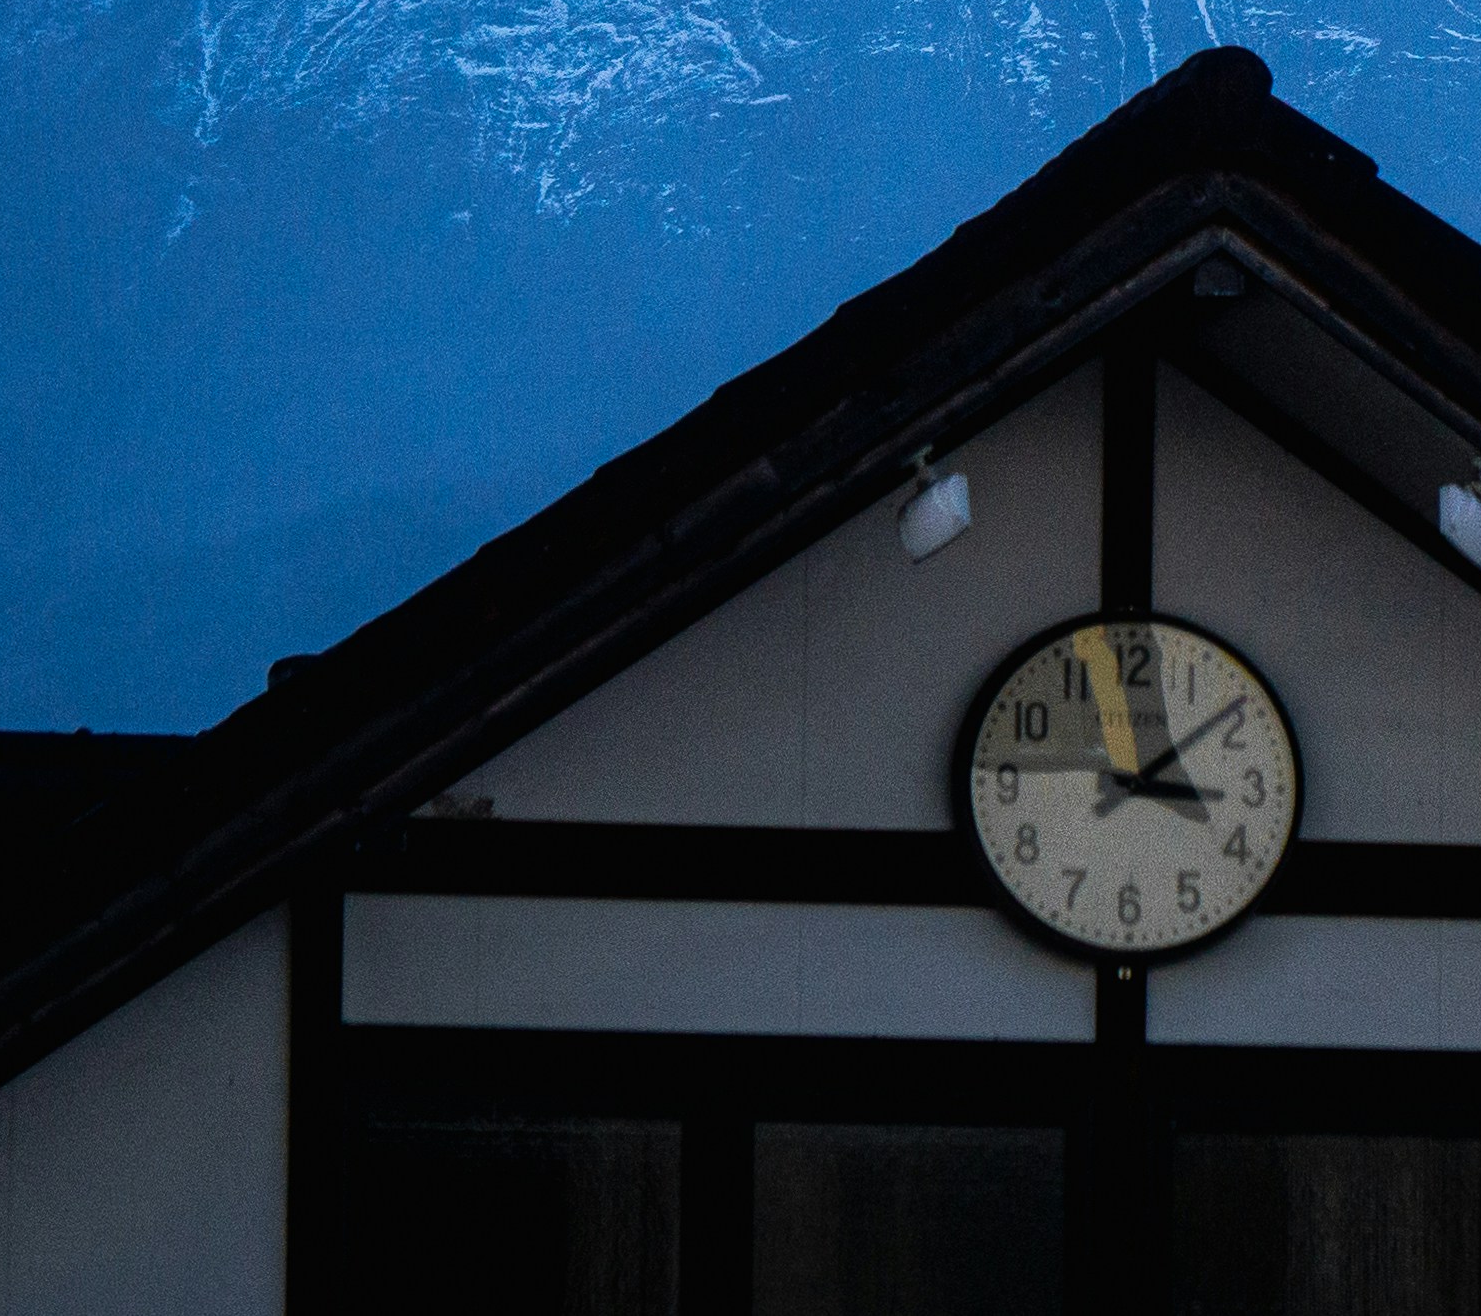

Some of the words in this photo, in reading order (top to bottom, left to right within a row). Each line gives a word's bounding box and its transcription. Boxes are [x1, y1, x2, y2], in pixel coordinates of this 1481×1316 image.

[1064, 658, 1087, 701] 11
[1117, 645, 1151, 687] 12
[1015, 700, 1048, 741] 10
[1222, 708, 1247, 750] 2
[997, 764, 1019, 805] 9
[1242, 770, 1266, 808] 3
[1014, 823, 1040, 865] 8
[1224, 824, 1252, 866] 4
[1062, 869, 1087, 910] 7
[1119, 880, 1142, 925] 6
[1177, 871, 1201, 914] 5
